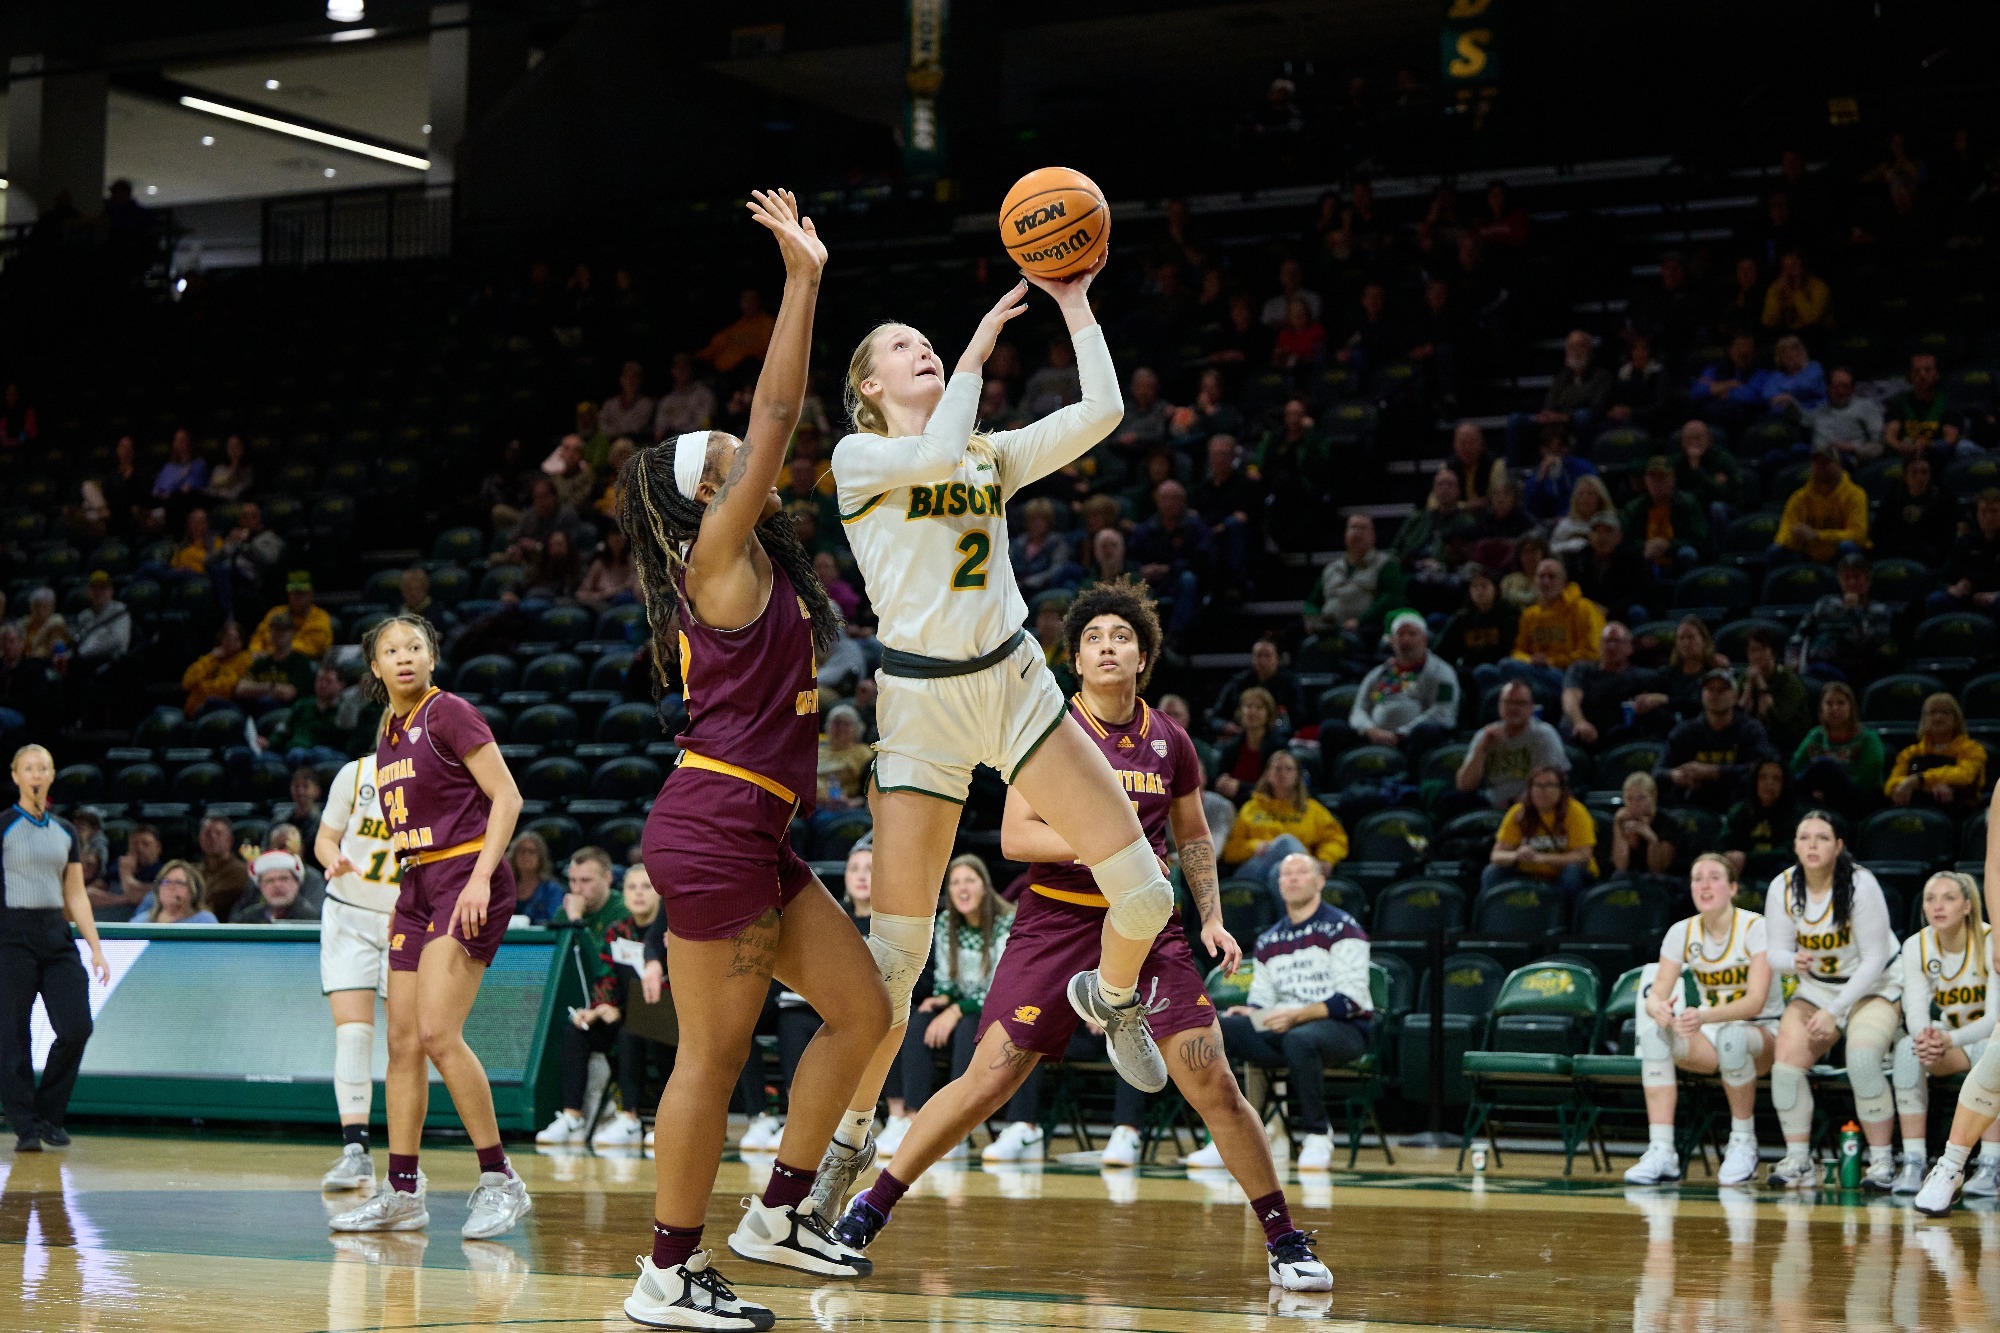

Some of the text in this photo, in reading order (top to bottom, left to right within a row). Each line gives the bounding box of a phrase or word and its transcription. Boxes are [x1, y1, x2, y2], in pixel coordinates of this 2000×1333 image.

[1014, 200, 1066, 236] NCAA
[1021, 229, 1092, 263] Wilson
[905, 481, 1003, 522] BISON
[949, 529, 992, 592] 2
[1115, 769, 1166, 795] TRAL
[384, 785, 409, 829] 24
[1820, 955, 1839, 975] 3
[1843, 1139, 1858, 1157] G
